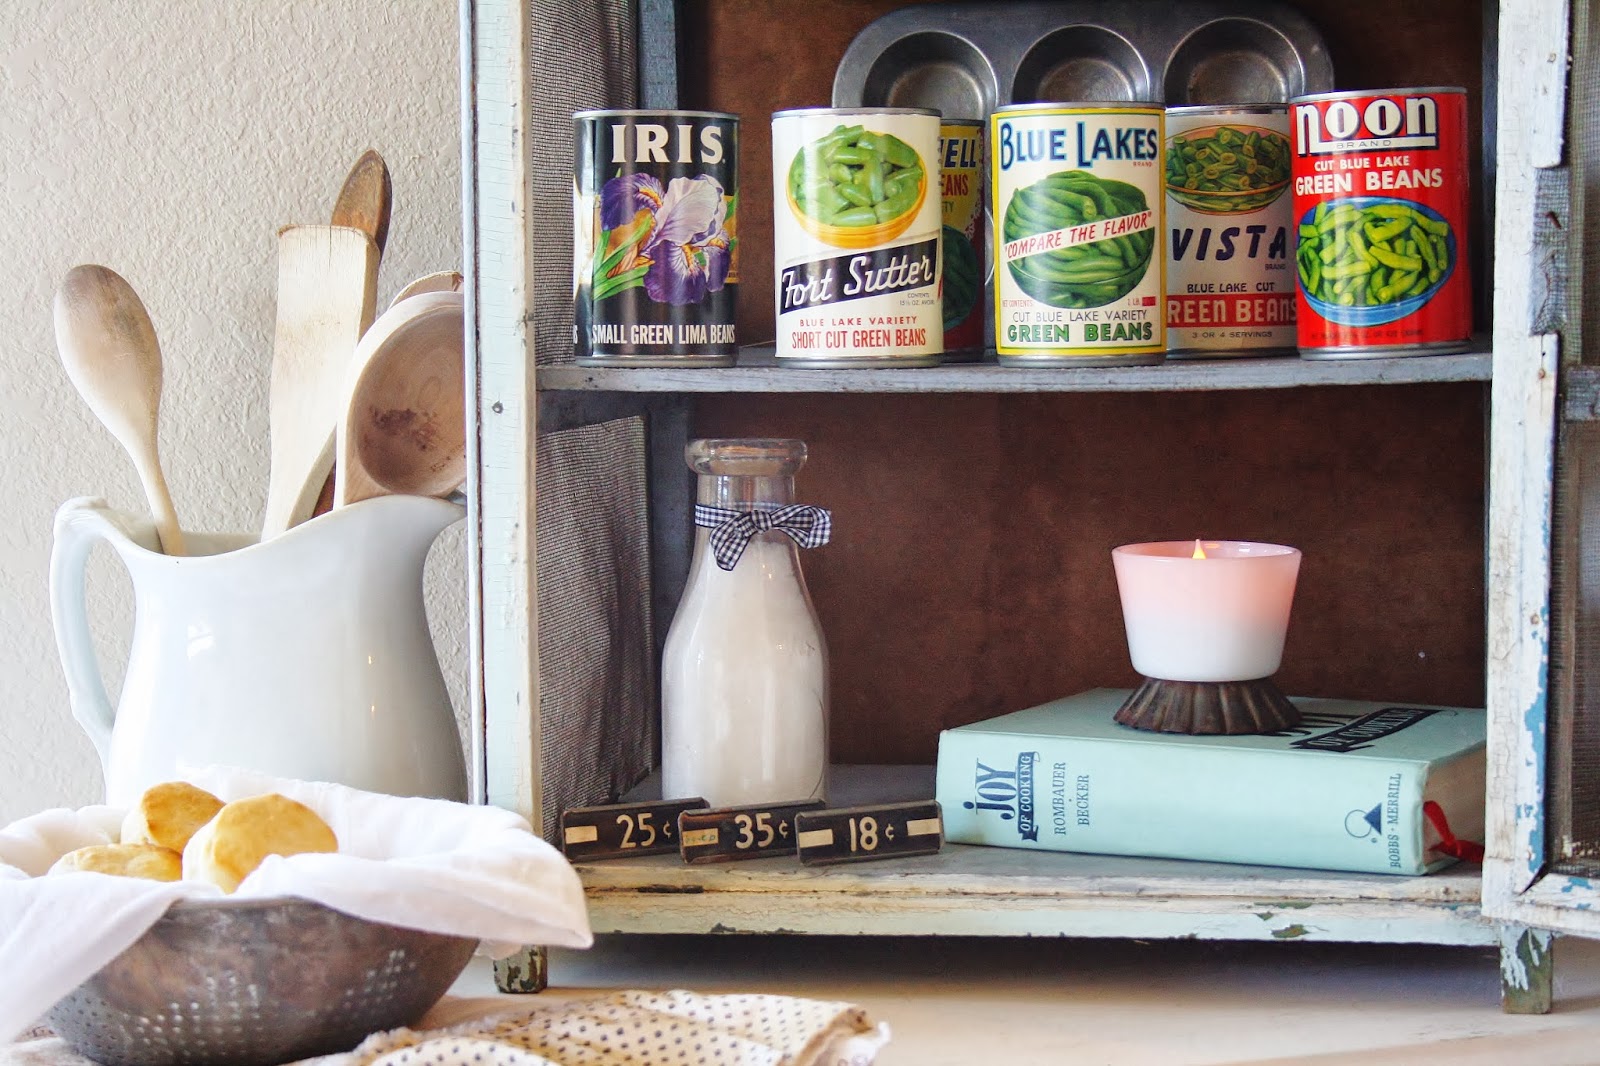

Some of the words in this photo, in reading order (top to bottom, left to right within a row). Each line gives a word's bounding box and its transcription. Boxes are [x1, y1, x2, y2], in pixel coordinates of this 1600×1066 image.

[611, 124, 723, 165] IRIS
[940, 138, 977, 168] ELL
[1000, 121, 1067, 172] BLUE
[1076, 121, 1158, 169] LAKES
[1336, 139, 1392, 149] BRAND
[1314, 159, 1334, 172] CUT
[1339, 158, 1370, 170] BLUE
[1376, 155, 1410, 168] LAKE
[1295, 173, 1352, 196] GREEN
[1365, 168, 1444, 191] BEANS
[1070, 224, 1096, 244] THE
[1103, 211, 1153, 237] FLAVOR"
[1172, 225, 1287, 261] VISTA
[781, 270, 833, 309] Fort
[843, 254, 933, 296] Sutter
[1187, 283, 1215, 293] BLUE
[1219, 282, 1248, 293] LAKE
[1255, 281, 1276, 292] CUT
[799, 318, 825, 328] BLUE
[831, 316, 863, 326] LAKE
[869, 315, 918, 325] VARIETY
[1012, 311, 1031, 323] CUT
[1036, 311, 1063, 322] BLUE
[1069, 311, 1099, 322] LAKE
[1105, 309, 1148, 321] VARIETY
[1167, 299, 1227, 324] REEN
[592, 324, 628, 345] SMALL
[630, 324, 673, 345] GREEN
[678, 324, 708, 344] LIMA
[710, 324, 735, 344] BEANS
[791, 331, 821, 349] SHORT
[825, 330, 848, 349] CUT
[852, 330, 894, 348] GREEN
[896, 328, 927, 347] BEANS
[1007, 323, 1070, 343] GREEN
[1083, 322, 1153, 343] BEANS
[1019, 755, 1033, 812] COOKING
[1051, 761, 1067, 835] ROMBAUER
[1076, 774, 1090, 826] BECKER
[1386, 773, 1402, 825] MERRILL
[1019, 814, 1031, 831] OF
[1387, 834, 1402, 868] BOBBS
